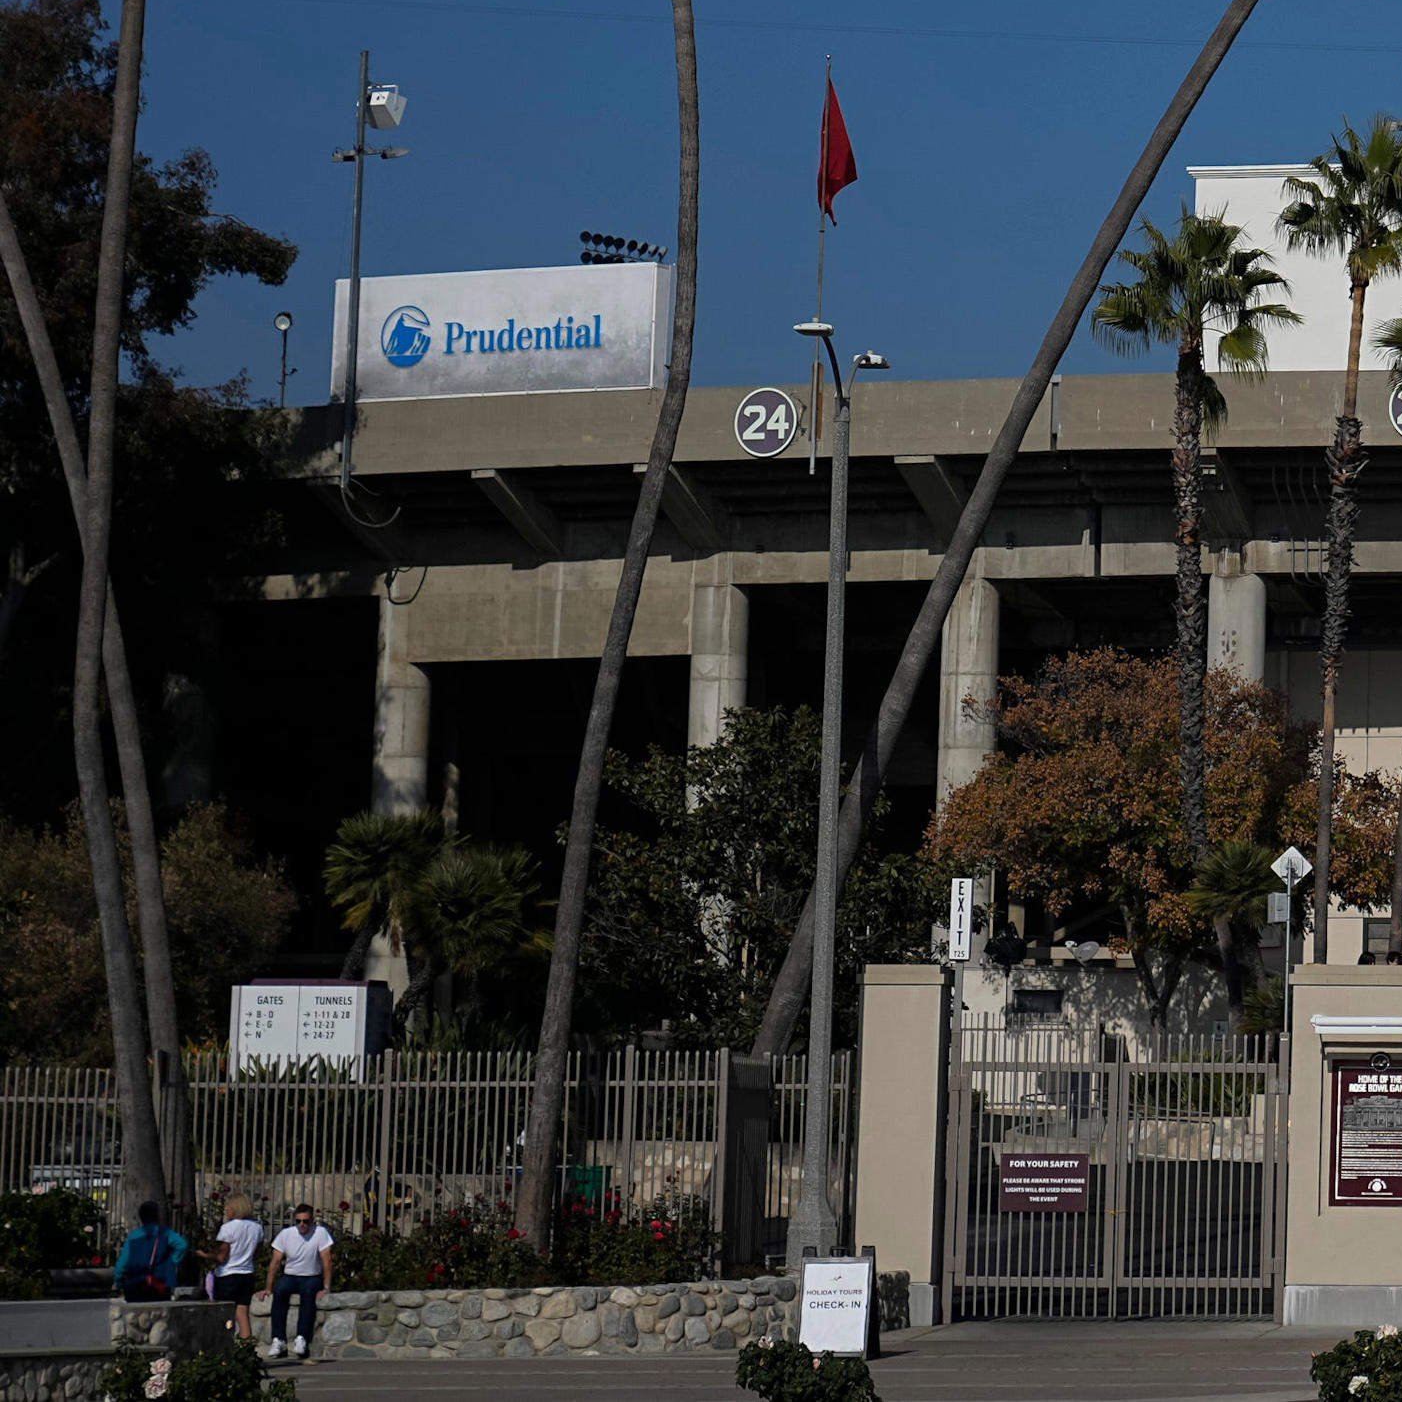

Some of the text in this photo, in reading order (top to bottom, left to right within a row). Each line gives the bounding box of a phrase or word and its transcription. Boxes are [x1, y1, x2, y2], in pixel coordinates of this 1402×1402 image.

[443, 314, 602, 355] Prudential
[742, 404, 789, 440] 24
[957, 881, 965, 945] EXIT
[257, 996, 284, 1005] GATES
[315, 996, 353, 1005] TUNNELS
[255, 1031, 261, 1039] N
[1358, 1075, 1402, 1083] HOME OF THE
[1349, 1083, 1367, 1093] ROSE
[1368, 1083, 1388, 1093] BOWL
[1009, 1160, 1079, 1168] FOR YOUR SAFETY
